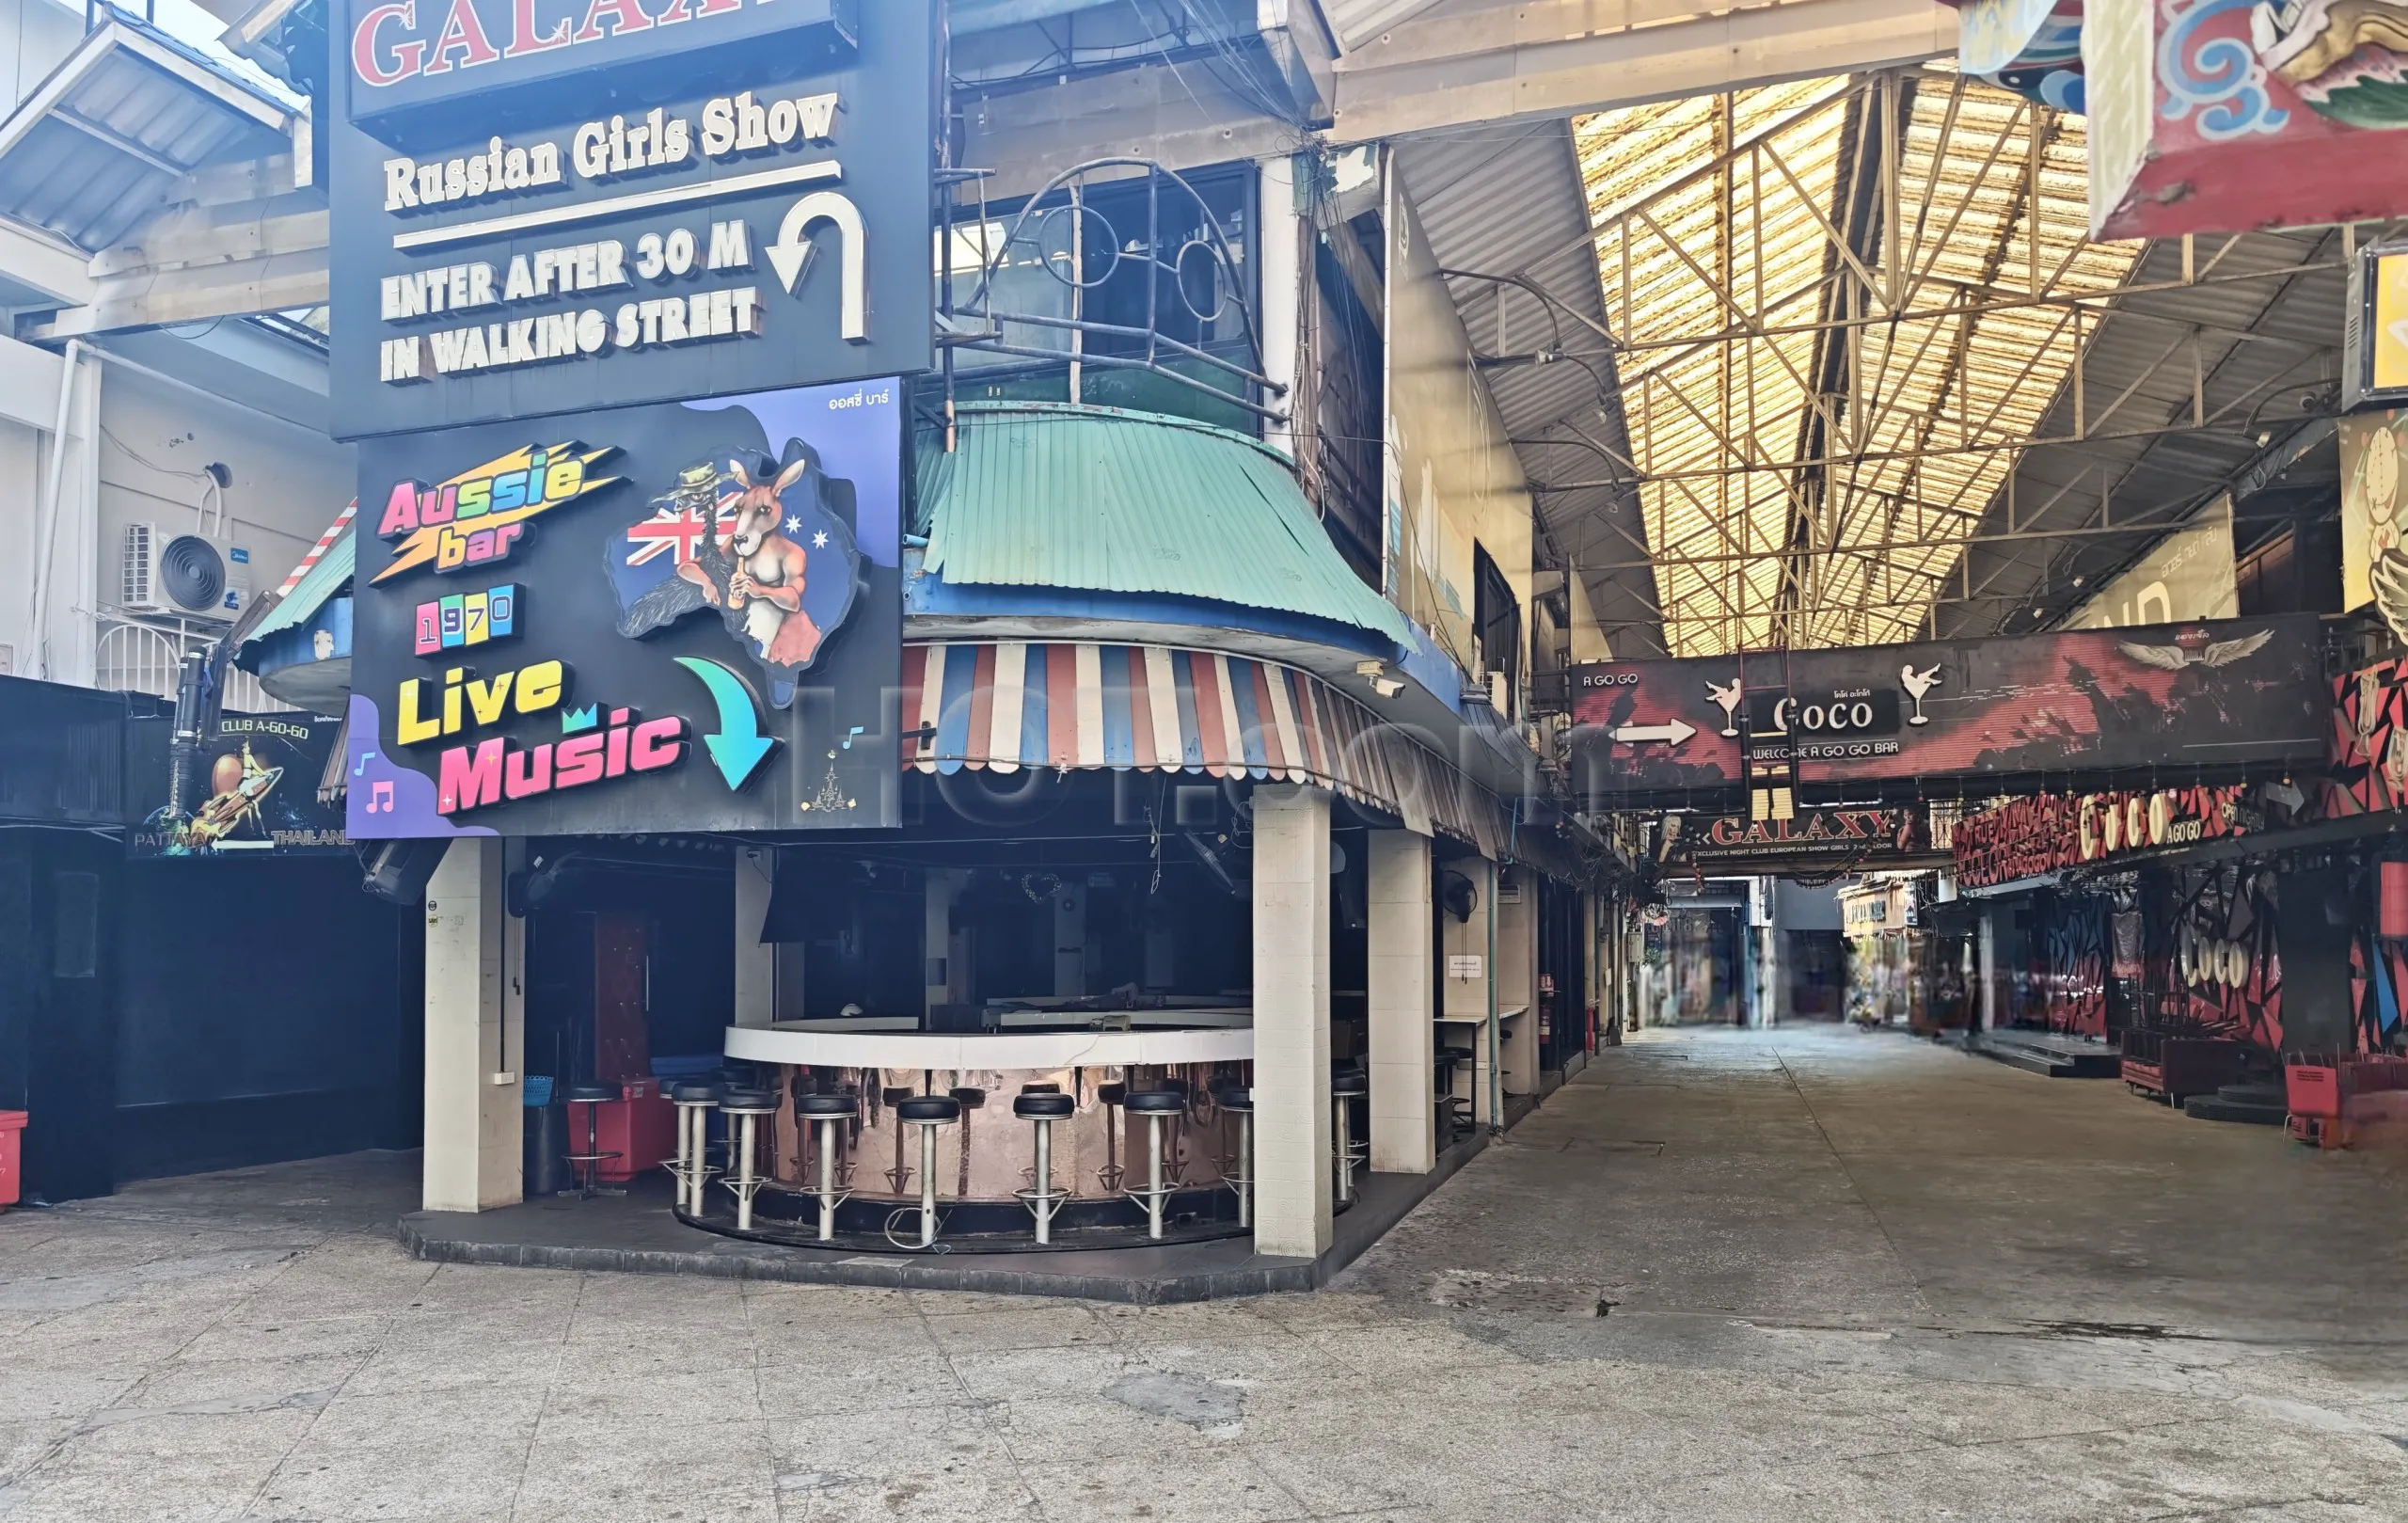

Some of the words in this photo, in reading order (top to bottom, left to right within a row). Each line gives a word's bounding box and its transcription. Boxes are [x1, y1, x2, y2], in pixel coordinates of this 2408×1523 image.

[352, 0, 773, 87] GALA
[383, 135, 562, 213] Russian
[573, 107, 689, 180] Girls
[701, 91, 839, 157] Show
[381, 262, 498, 322] ENTER
[503, 239, 631, 302] AFTER
[636, 229, 698, 280] 30
[707, 220, 750, 271] M
[380, 334, 420, 383] IN
[430, 309, 611, 375] WALKING
[615, 287, 756, 348] STREET
[865, 388, 889, 405] บาร์
[377, 452, 585, 537] Aussie
[436, 520, 524, 570] bar
[418, 595, 512, 646] 1970
[396, 658, 563, 747] Live
[1583, 675, 1592, 687] A
[1594, 674, 1615, 686] GO
[1617, 673, 1639, 685] GO
[221, 720, 253, 732] CLUB
[255, 720, 309, 740] A-GO-GO
[1810, 746, 1819, 756] A
[1823, 745, 1845, 756] GO
[1848, 744, 1870, 755] GO
[1874, 741, 1899, 754] BAR
[436, 706, 683, 816] Music
[135, 832, 207, 848] PATTAYA
[1711, 808, 1892, 846] GALAXY
[1770, 846, 1807, 854] EUROPEAN
[1808, 844, 1829, 852] SHOW
[2187, 820, 2201, 841] GO
